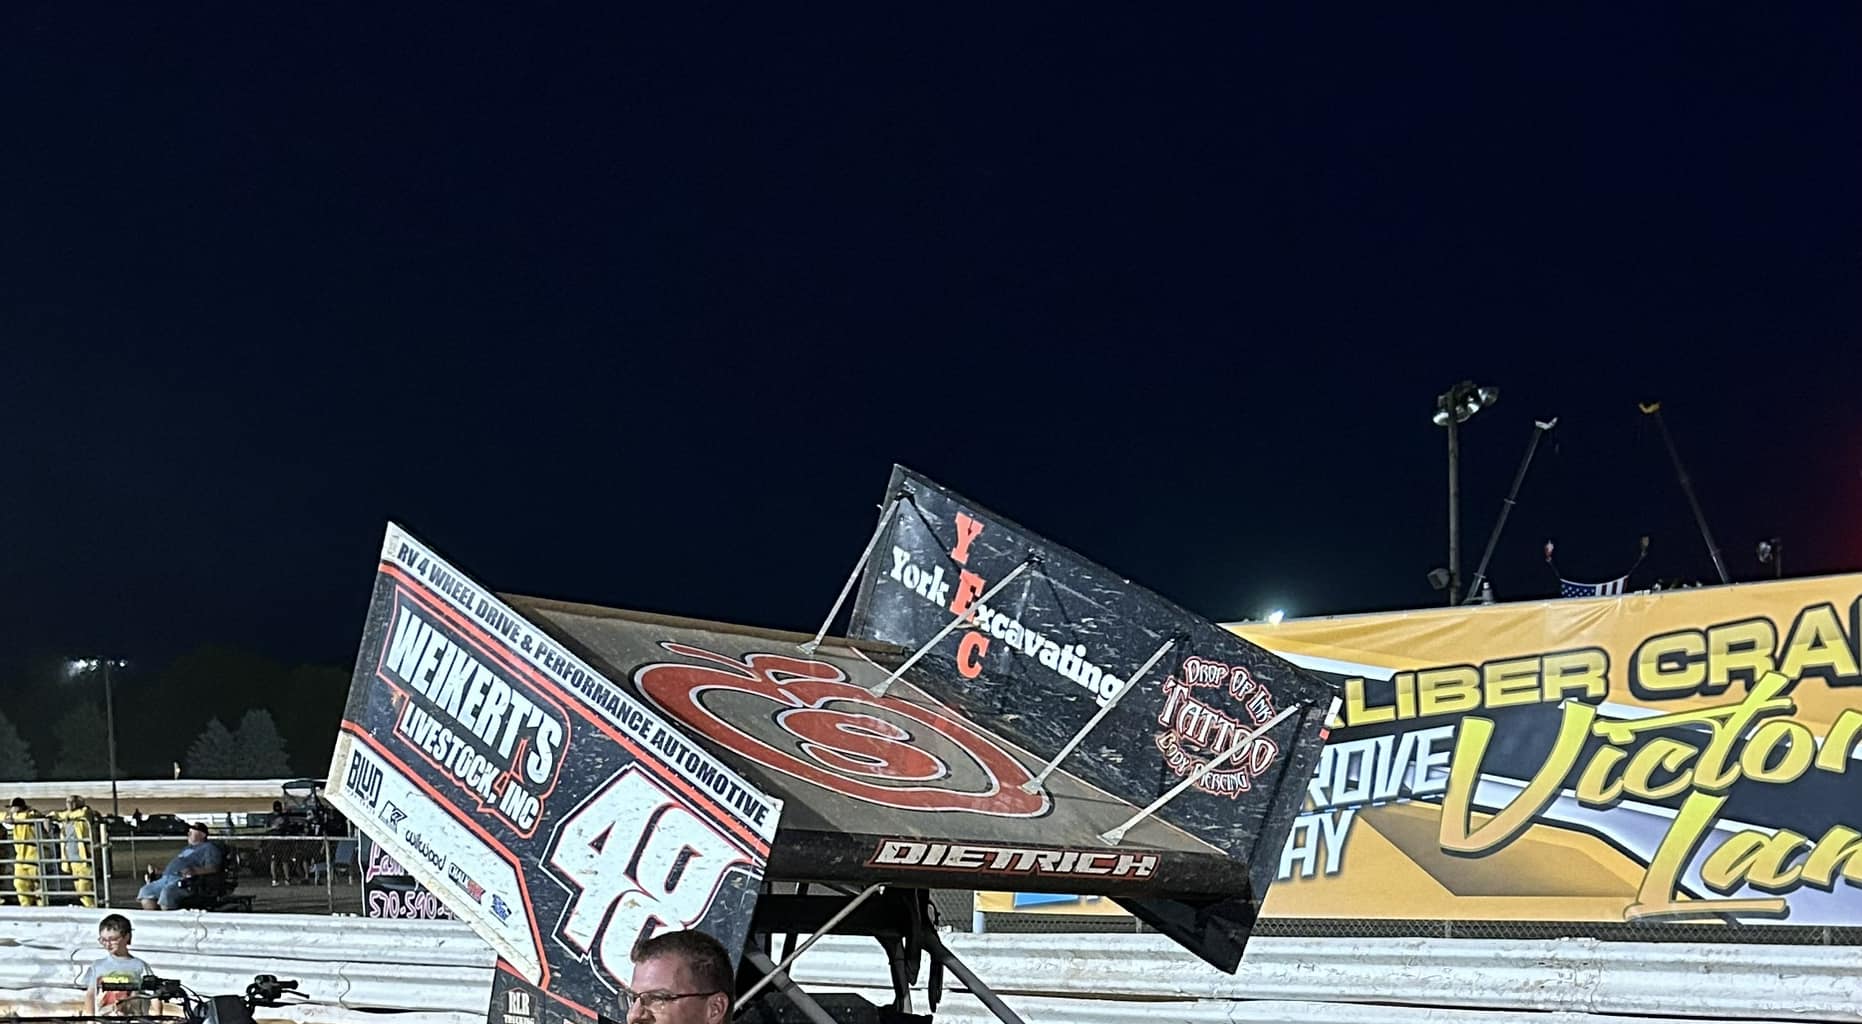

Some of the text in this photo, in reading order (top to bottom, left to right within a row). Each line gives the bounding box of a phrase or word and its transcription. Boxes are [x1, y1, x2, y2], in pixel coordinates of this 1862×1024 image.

[890, 545, 950, 607] York
[386, 604, 562, 784] WEIKERT'S
[397, 542, 770, 827] RV 4 WHEEL DRIVE & PERFORMANCE AUTOMOTIVE
[1334, 606, 1862, 728] LIBER CRA
[499, 780, 539, 829] INC
[875, 841, 1158, 877] DIETRICH
[550, 766, 758, 990] 48
